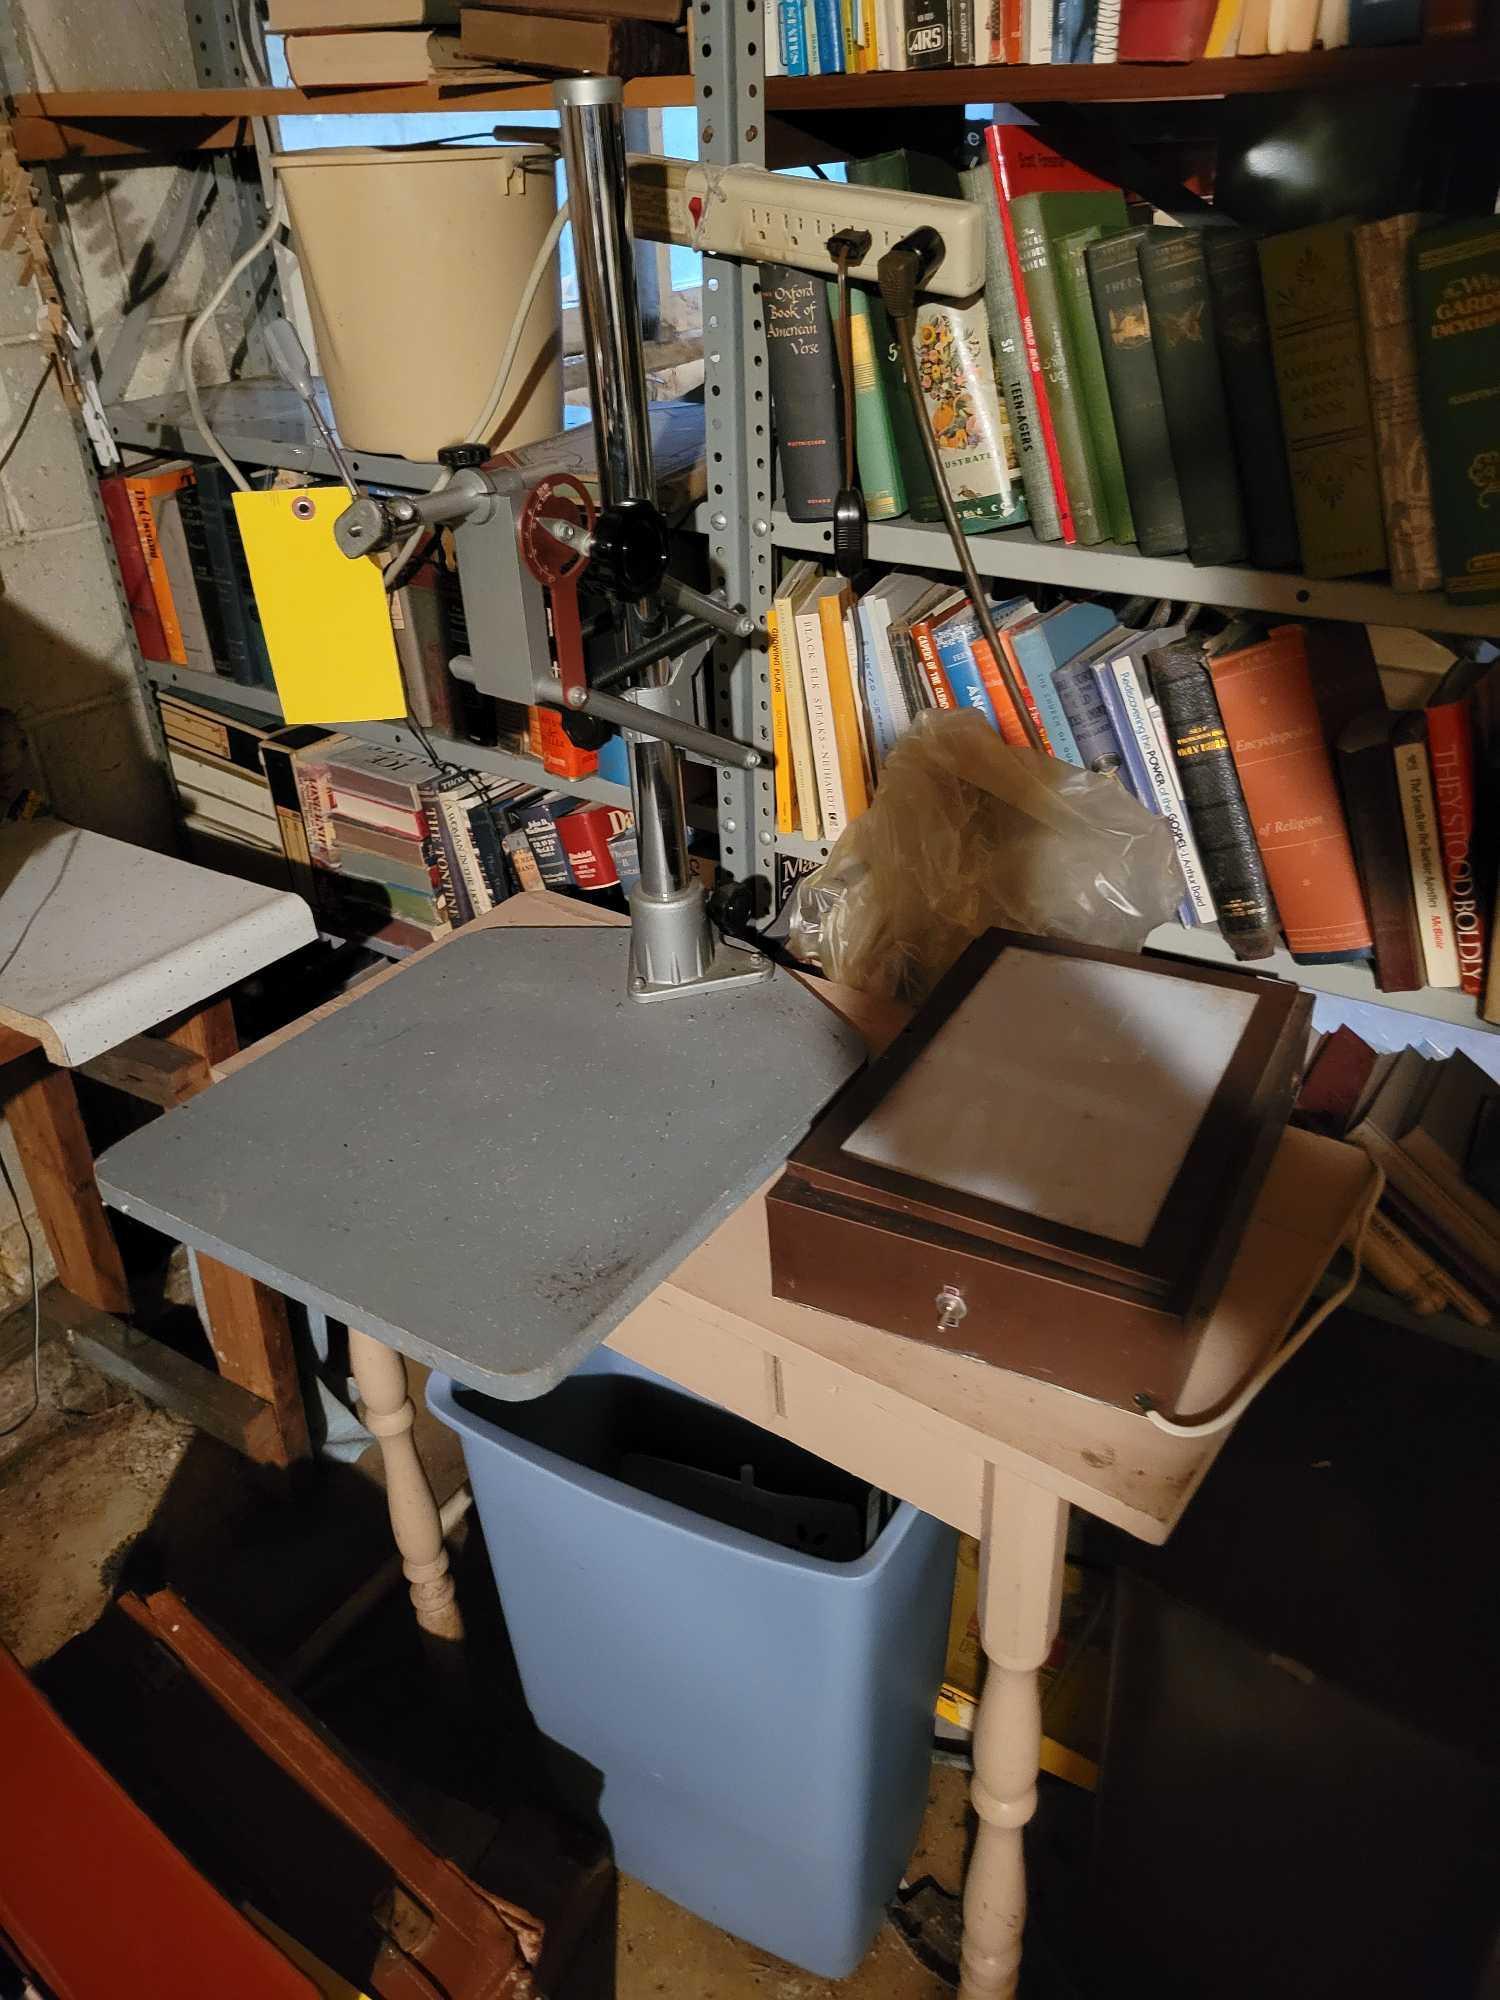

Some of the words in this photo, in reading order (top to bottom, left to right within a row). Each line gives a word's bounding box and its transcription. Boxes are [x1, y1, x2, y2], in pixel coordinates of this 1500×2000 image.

[909, 28, 943, 51] ARS
[768, 303, 801, 320] Book
[803, 301, 817, 324] of
[774, 281, 815, 304] Oxford
[767, 324, 818, 338] American
[790, 338, 820, 355] Verse
[1010, 380, 1033, 452] TEEN-AGERS
[803, 621, 816, 659] BLACK
[809, 665, 820, 689] ELK
[814, 697, 827, 741] SPEAKS
[1435, 744, 1463, 808] THEY
[1146, 750, 1165, 786] POWER
[1168, 813, 1187, 848] GOSPEL
[447, 811, 466, 853] WOMAN
[1258, 823, 1272, 837] of
[1275, 814, 1323, 834] Religion
[425, 807, 442, 841] THE
[435, 846, 460, 918] TONTINE
[1441, 814, 1474, 896] STOOD
[1453, 900, 1484, 980] BOLDLY
